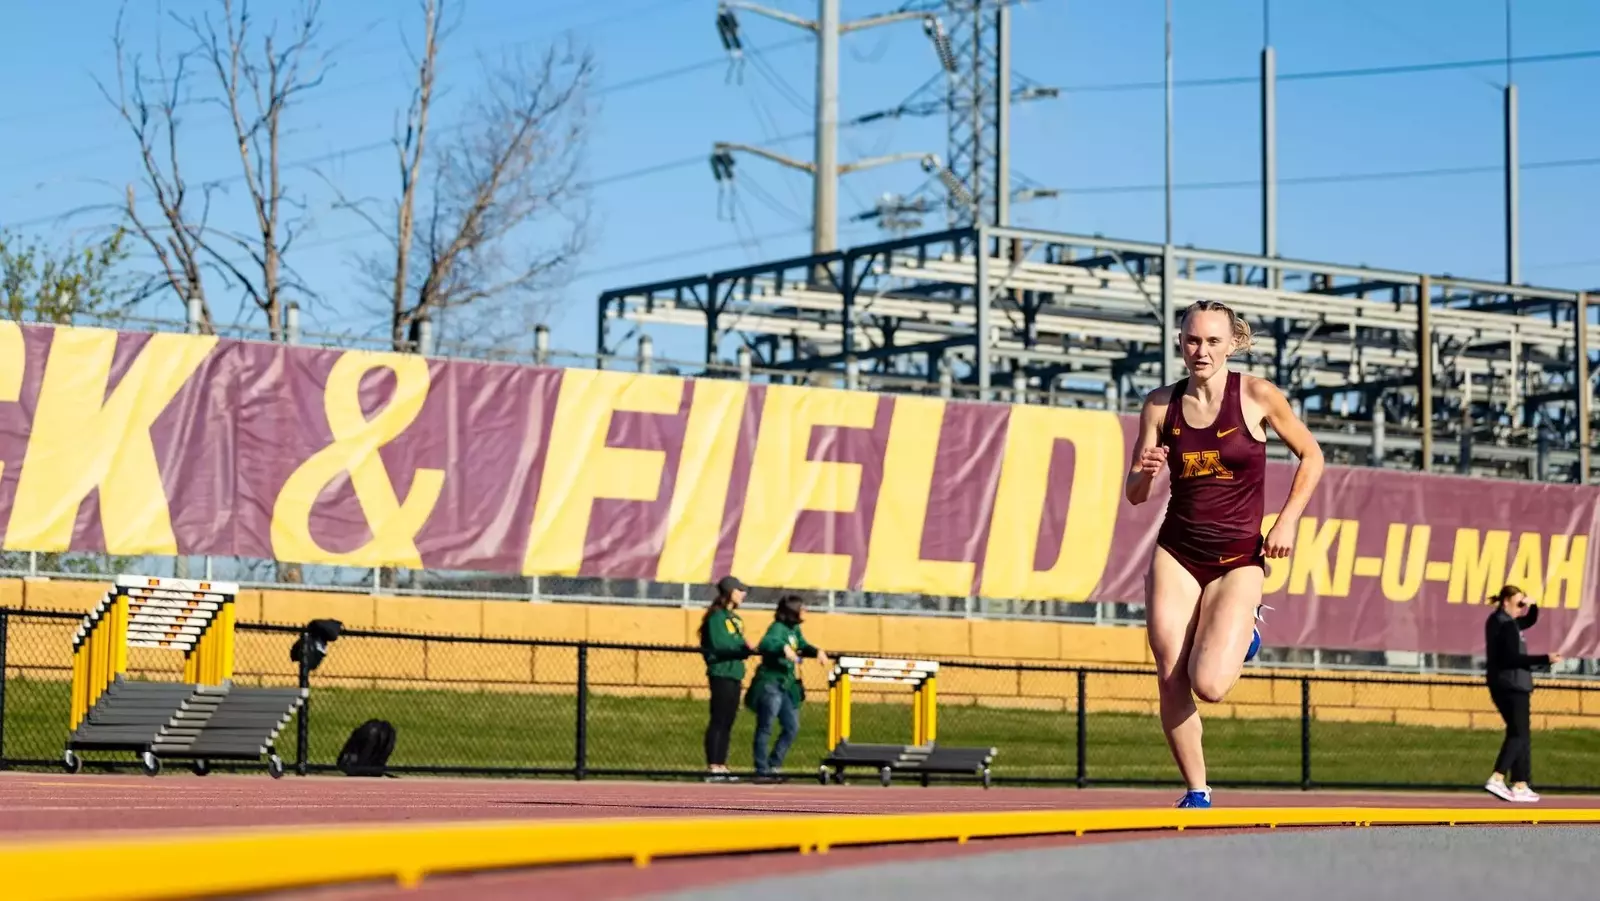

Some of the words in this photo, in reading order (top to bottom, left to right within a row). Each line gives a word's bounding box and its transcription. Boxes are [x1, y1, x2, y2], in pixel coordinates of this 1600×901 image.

[0, 319, 219, 555] K
[270, 350, 446, 569] &
[522, 367, 1125, 602] FIELD
[1180, 450, 1234, 479] M
